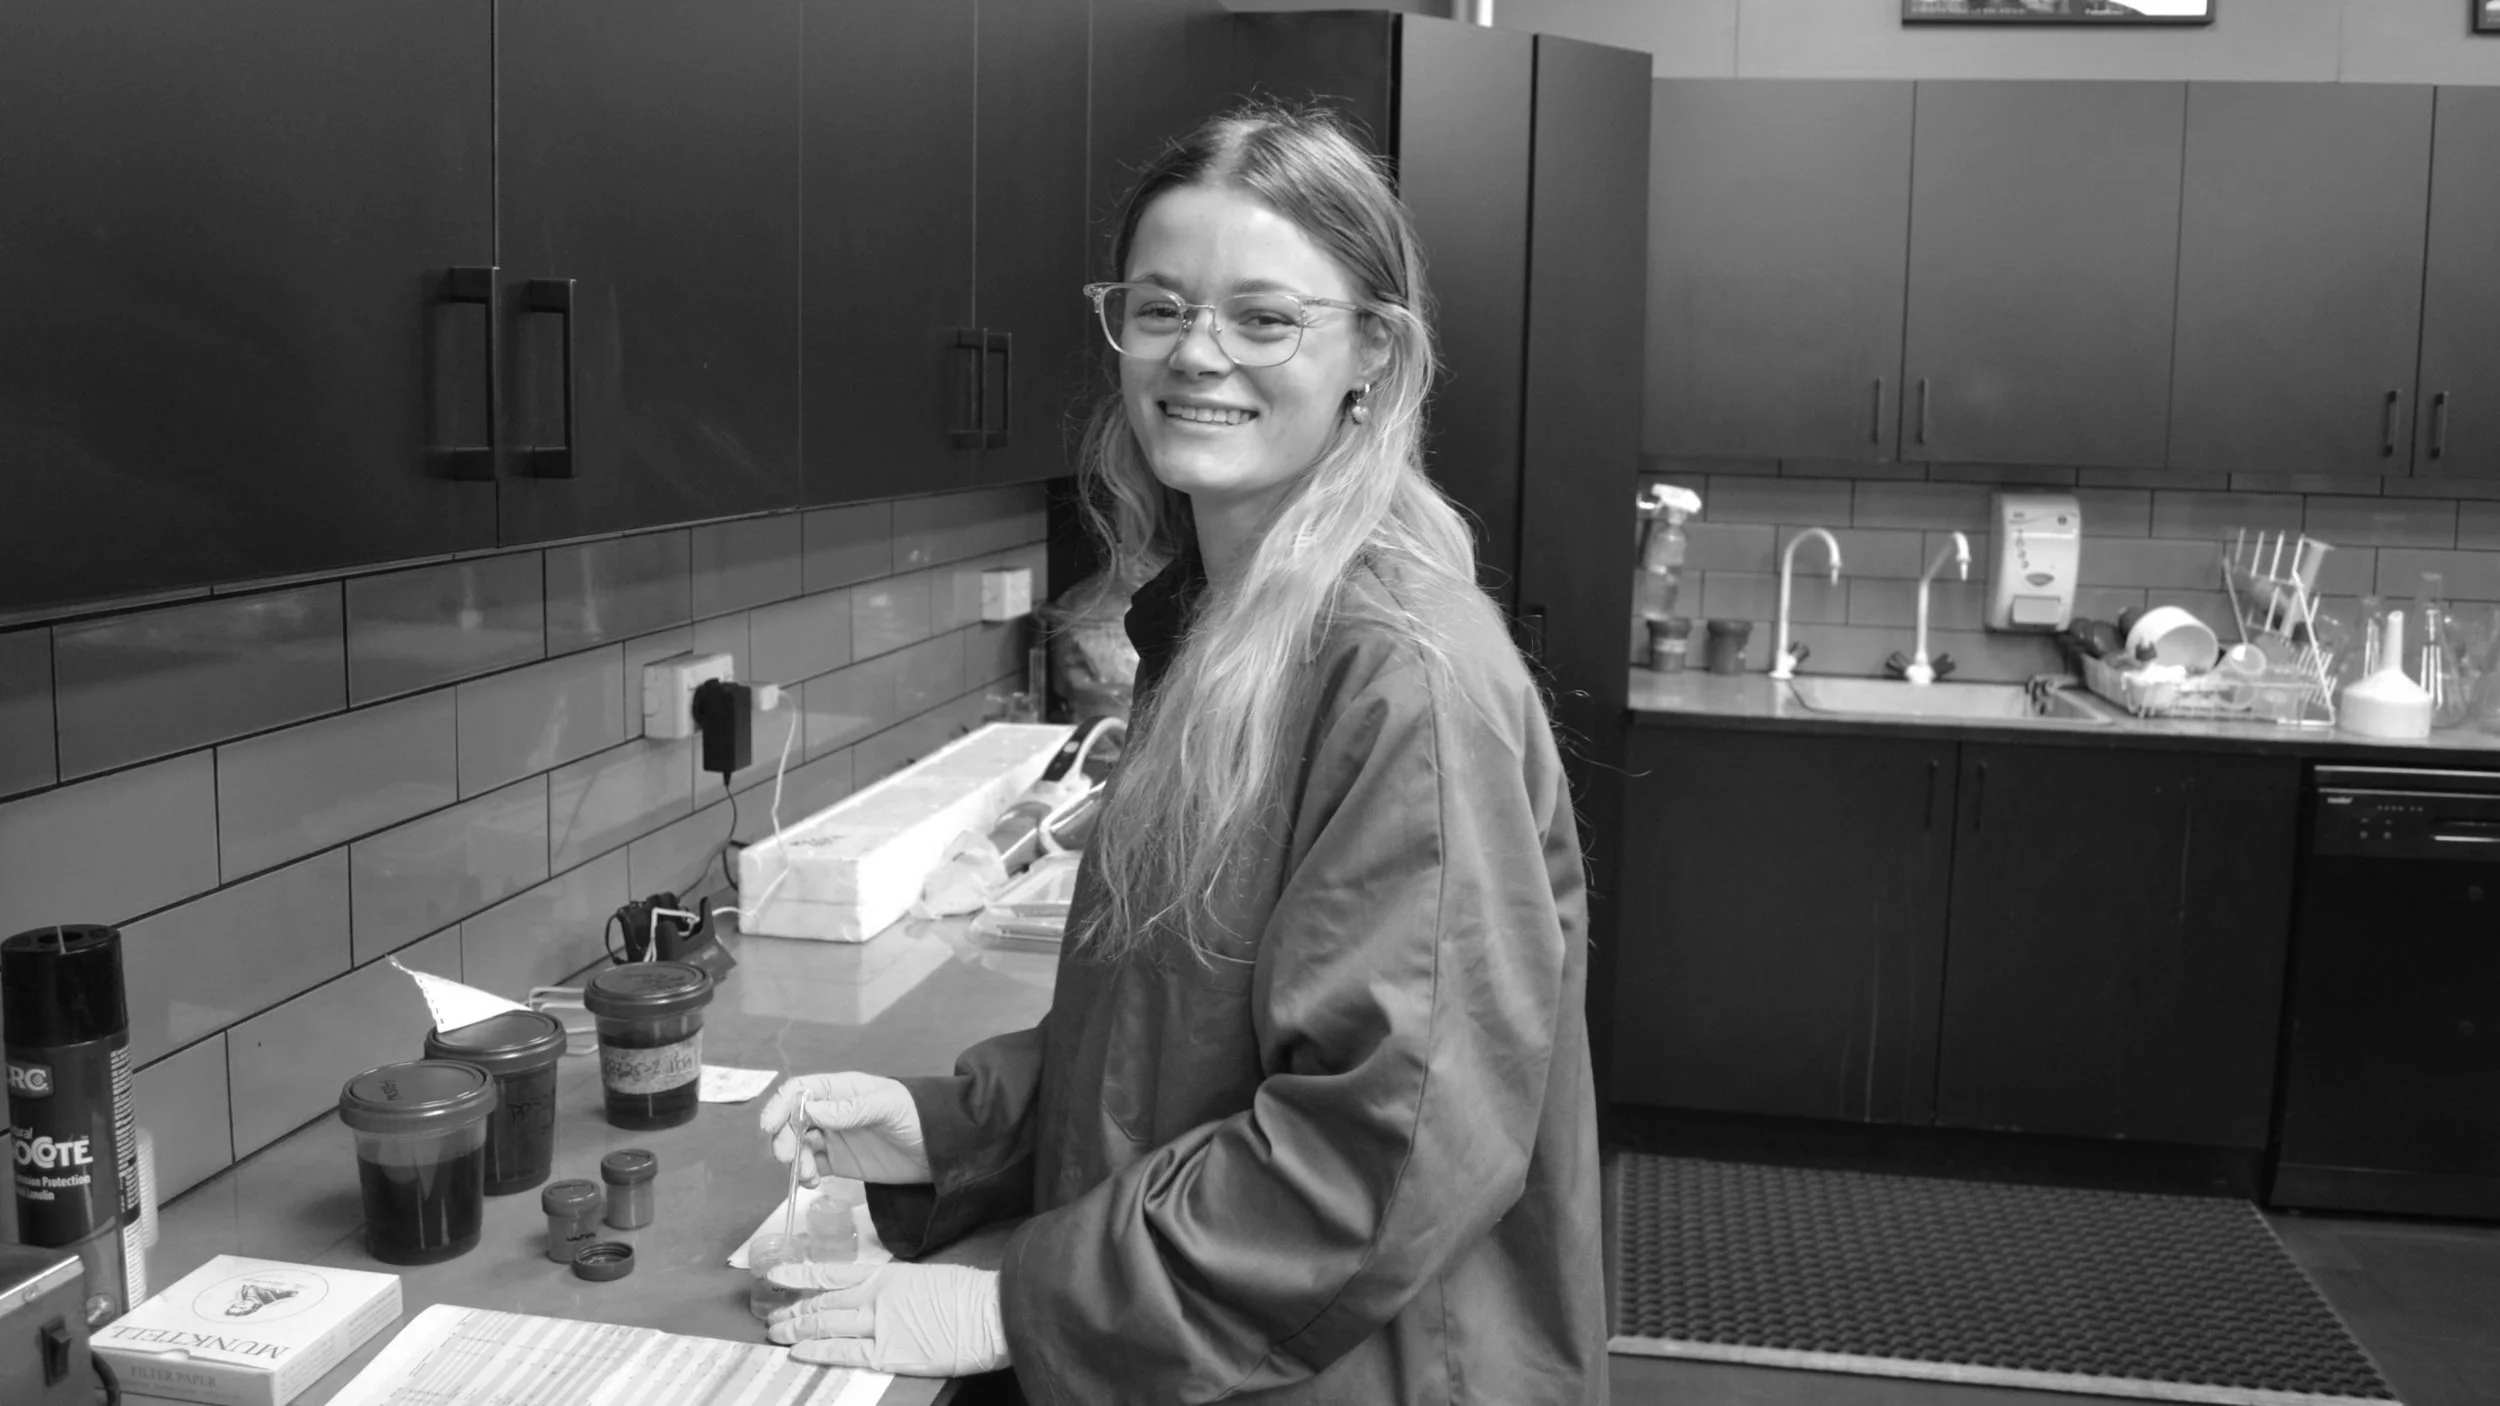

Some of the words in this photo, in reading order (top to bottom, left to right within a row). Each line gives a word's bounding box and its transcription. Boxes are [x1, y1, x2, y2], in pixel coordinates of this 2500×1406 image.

[8, 1065, 48, 1091] RC
[14, 1136, 94, 1169] OCOTE
[42, 1174, 91, 1187] Protection
[110, 1325, 293, 1359] MUNKTELL
[130, 1365, 173, 1381] FILTER
[176, 1372, 216, 1387] PAPER
